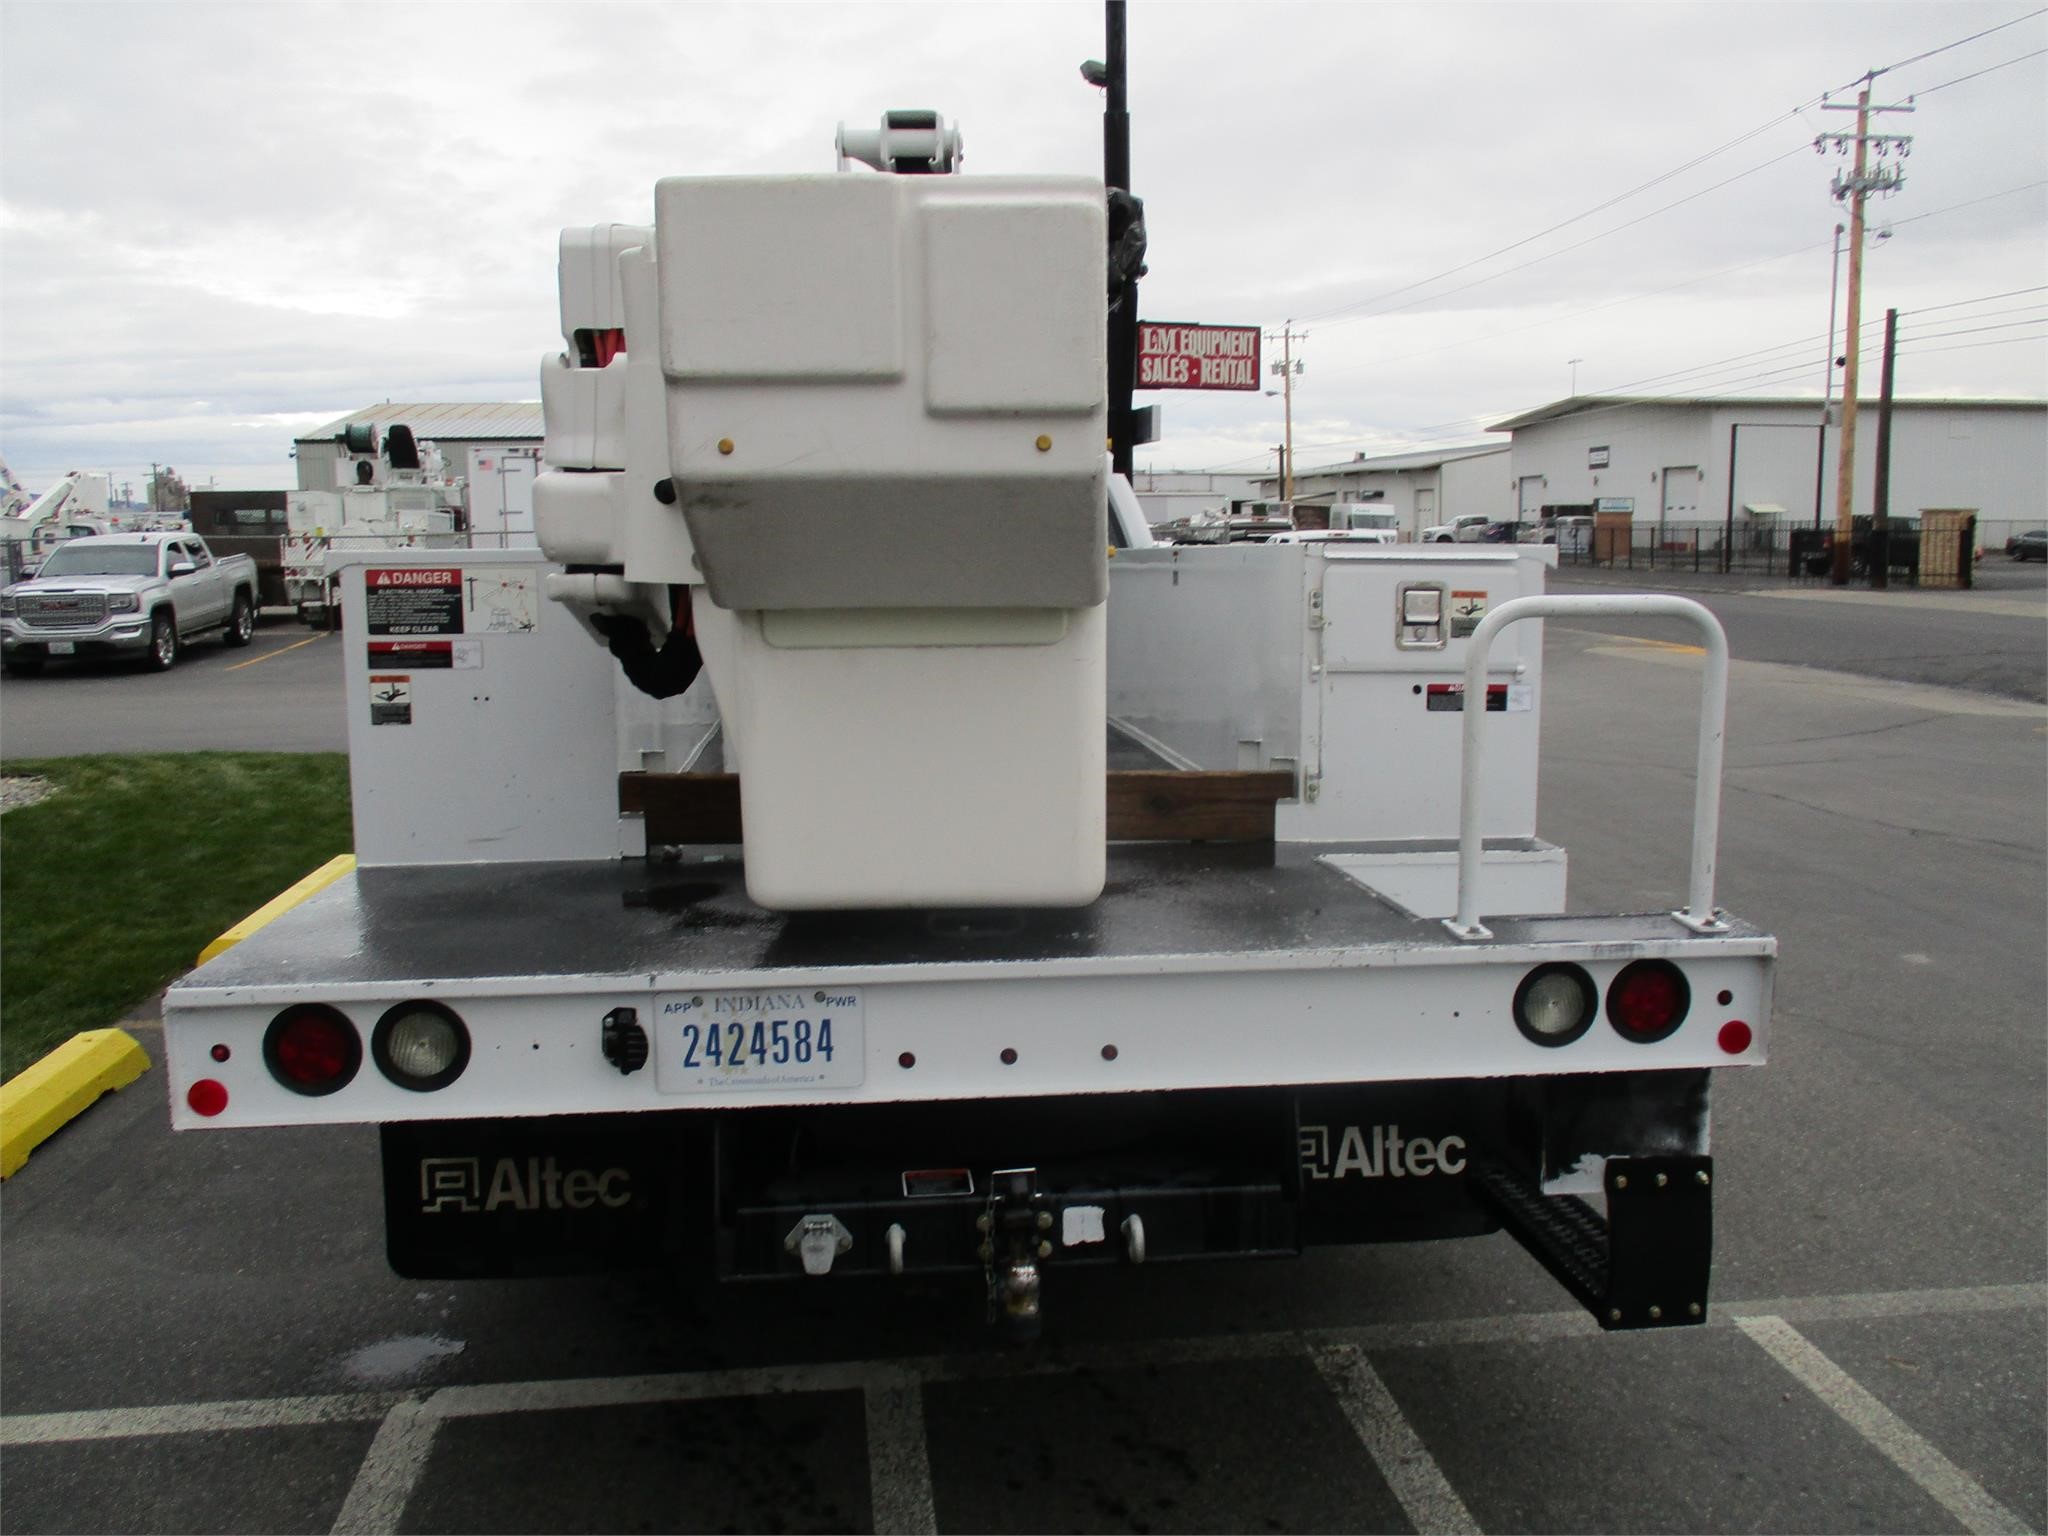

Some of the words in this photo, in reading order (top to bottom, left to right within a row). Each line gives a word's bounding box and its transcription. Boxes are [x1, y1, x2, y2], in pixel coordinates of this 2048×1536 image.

[1180, 328, 1257, 358] EQUIPMENT
[1141, 356, 1189, 383] SALES
[1200, 358, 1255, 385] RENTAL
[392, 571, 452, 585] DANGER
[389, 625, 411, 633] KEEP
[411, 625, 439, 633] CLEAR
[664, 1003, 692, 1015] APP
[714, 994, 805, 1013] INDIANA
[825, 996, 857, 1007] PWR
[683, 1018, 833, 1068] 2424584
[1333, 1124, 1467, 1178] Altec
[484, 1156, 632, 1211] Altec
